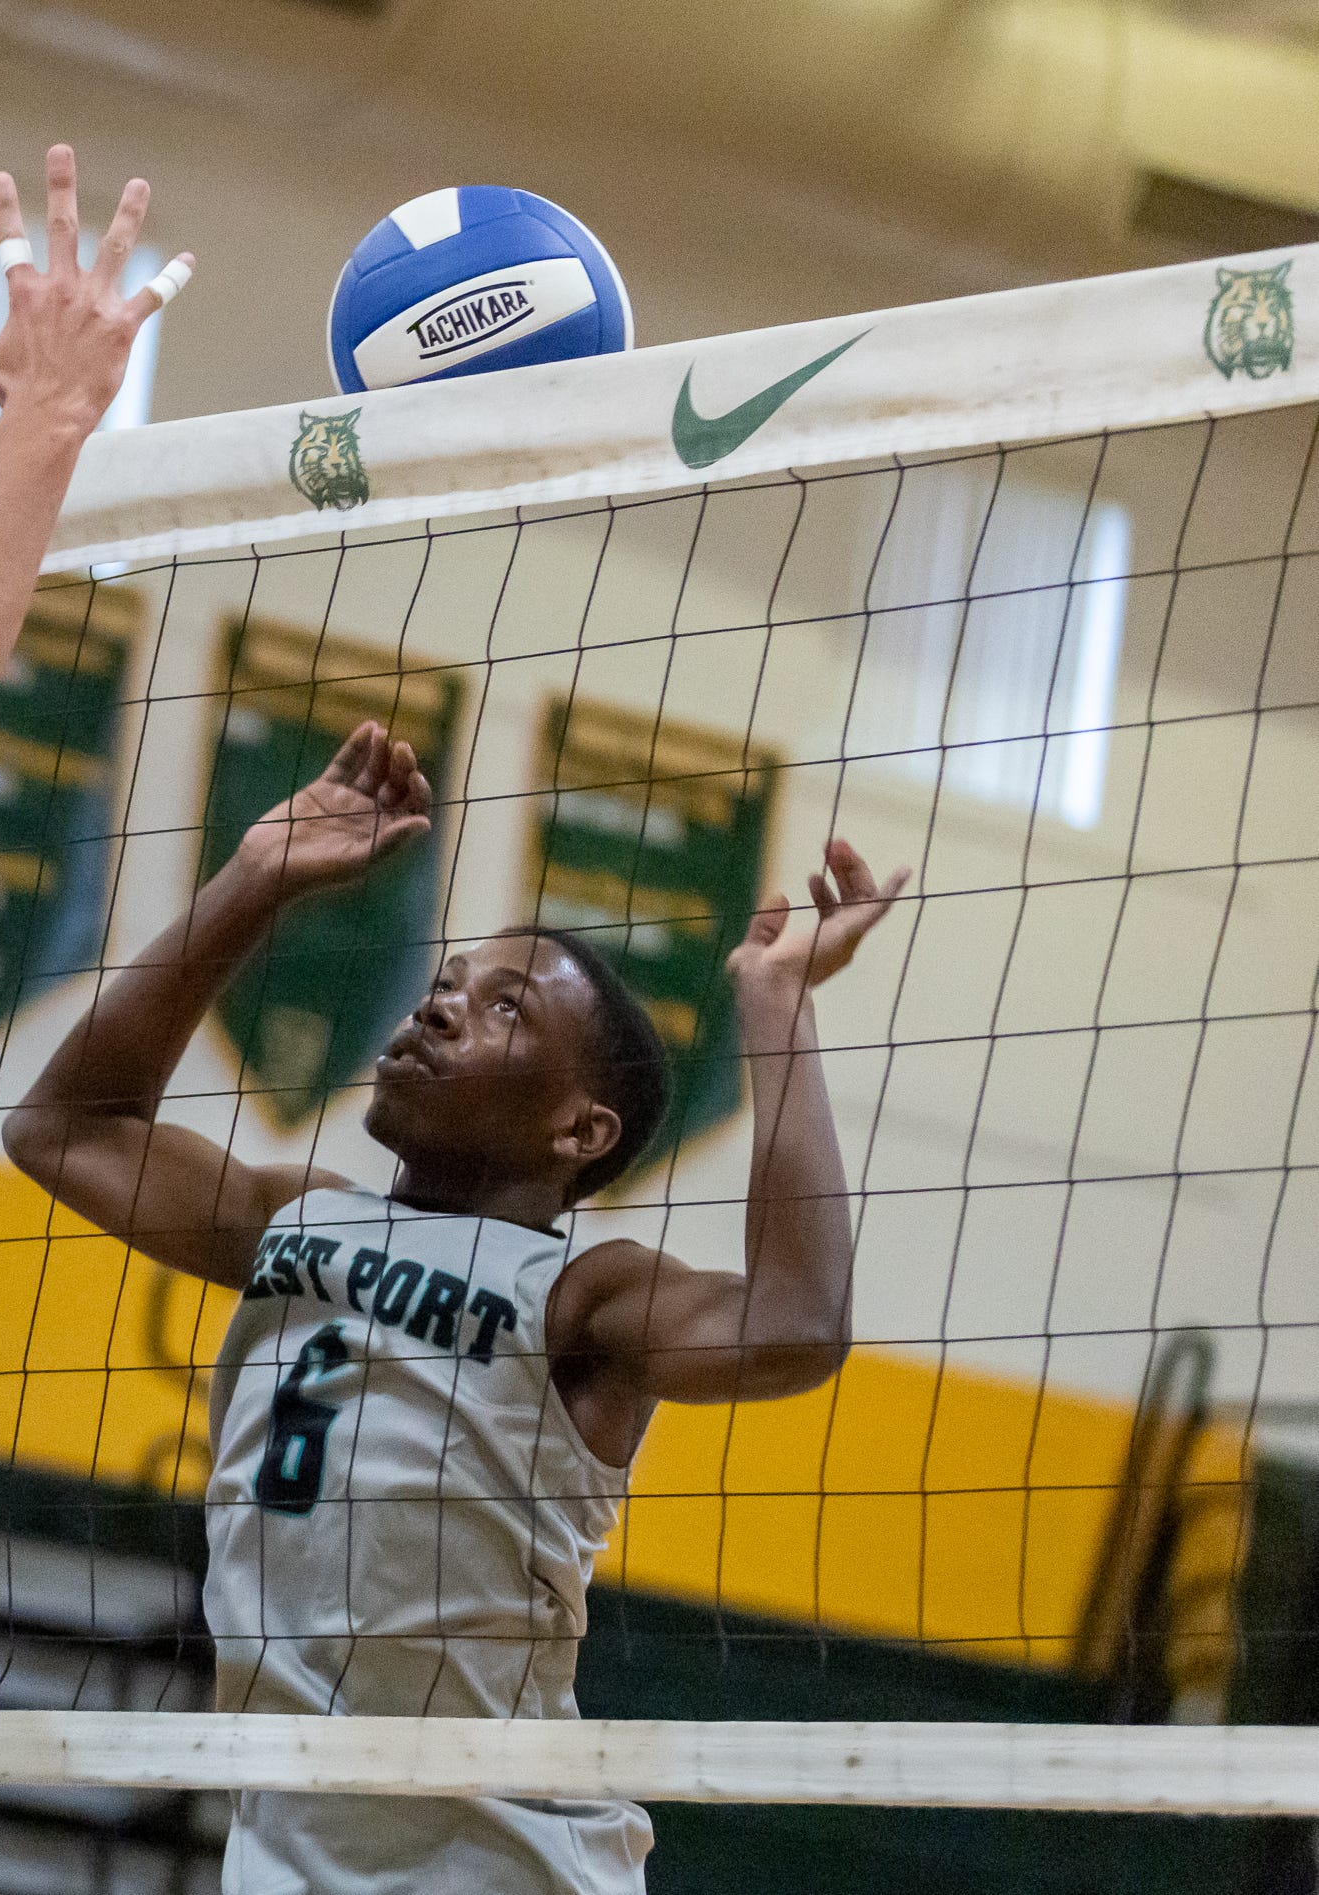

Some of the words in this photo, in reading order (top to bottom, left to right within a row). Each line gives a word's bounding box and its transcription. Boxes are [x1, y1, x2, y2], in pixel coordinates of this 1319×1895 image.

[406, 289, 529, 349] TACHIKARA
[242, 1232, 342, 1303] EST
[345, 1246, 518, 1367] PORT
[253, 1317, 349, 1518] 6
